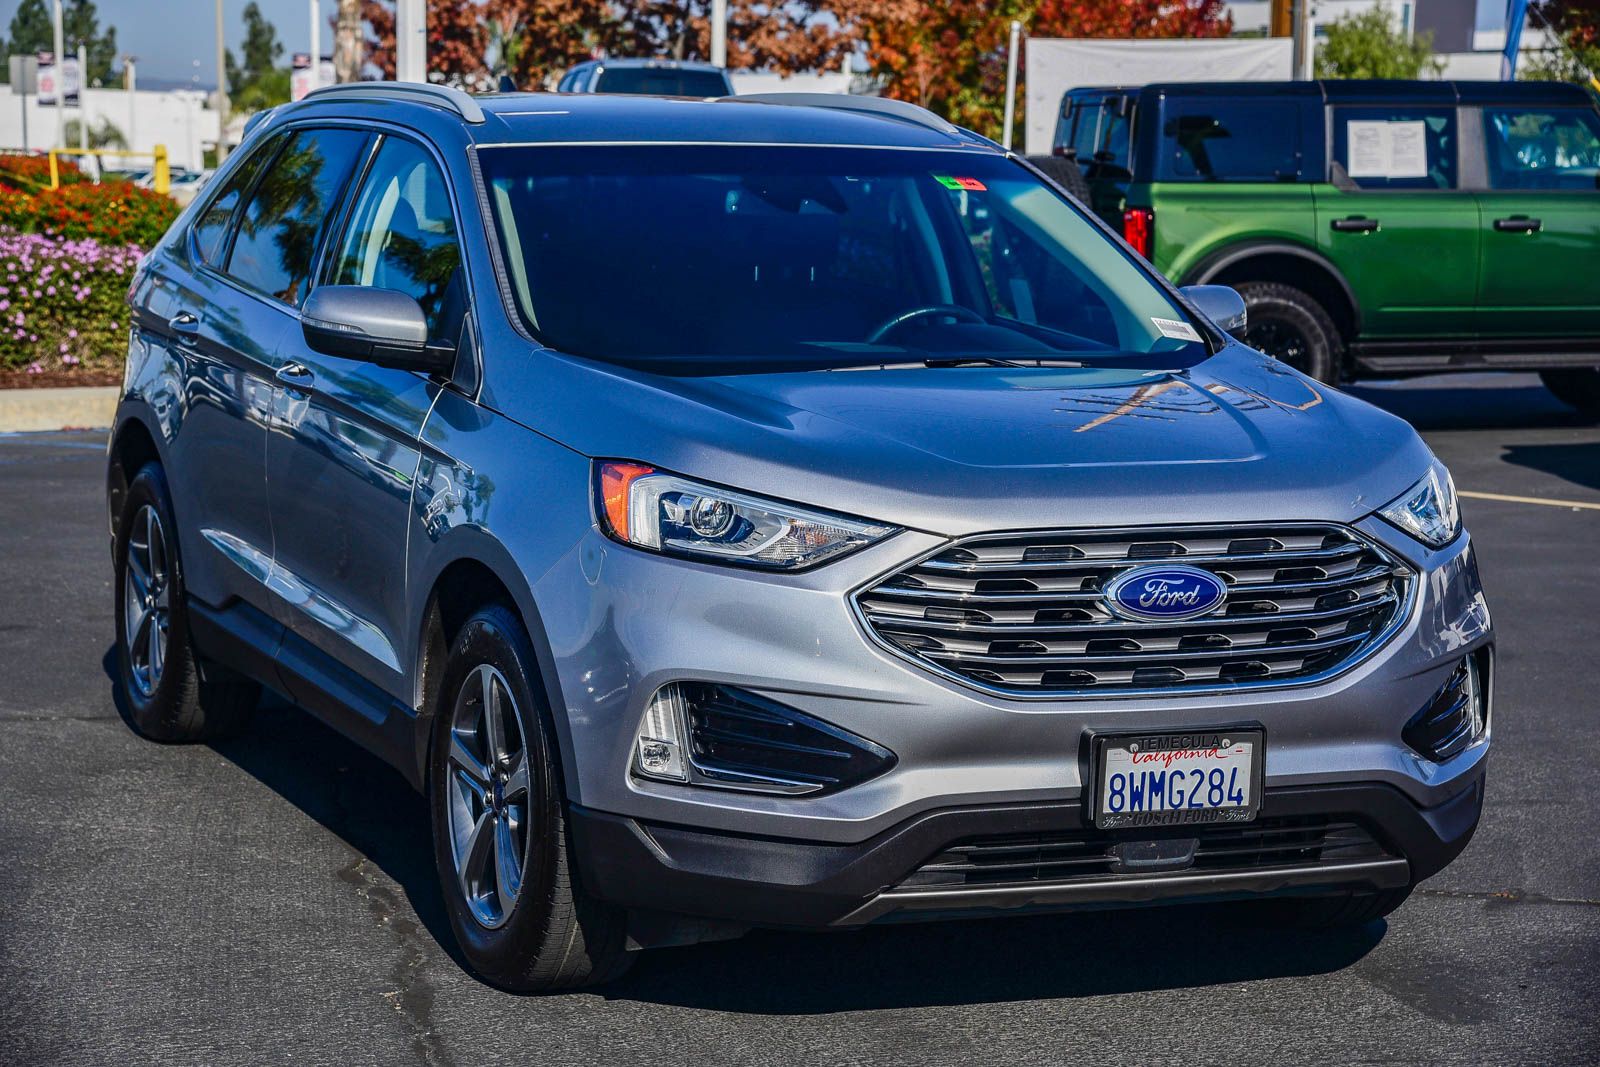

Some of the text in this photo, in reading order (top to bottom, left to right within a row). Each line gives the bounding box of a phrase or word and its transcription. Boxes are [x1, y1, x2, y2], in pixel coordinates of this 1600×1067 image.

[1139, 578, 1201, 607] Ford
[1138, 735, 1221, 751] TEMECULA
[1132, 747, 1229, 768] California
[1109, 767, 1243, 812] 8WMG284
[1185, 809, 1219, 822] FORD
